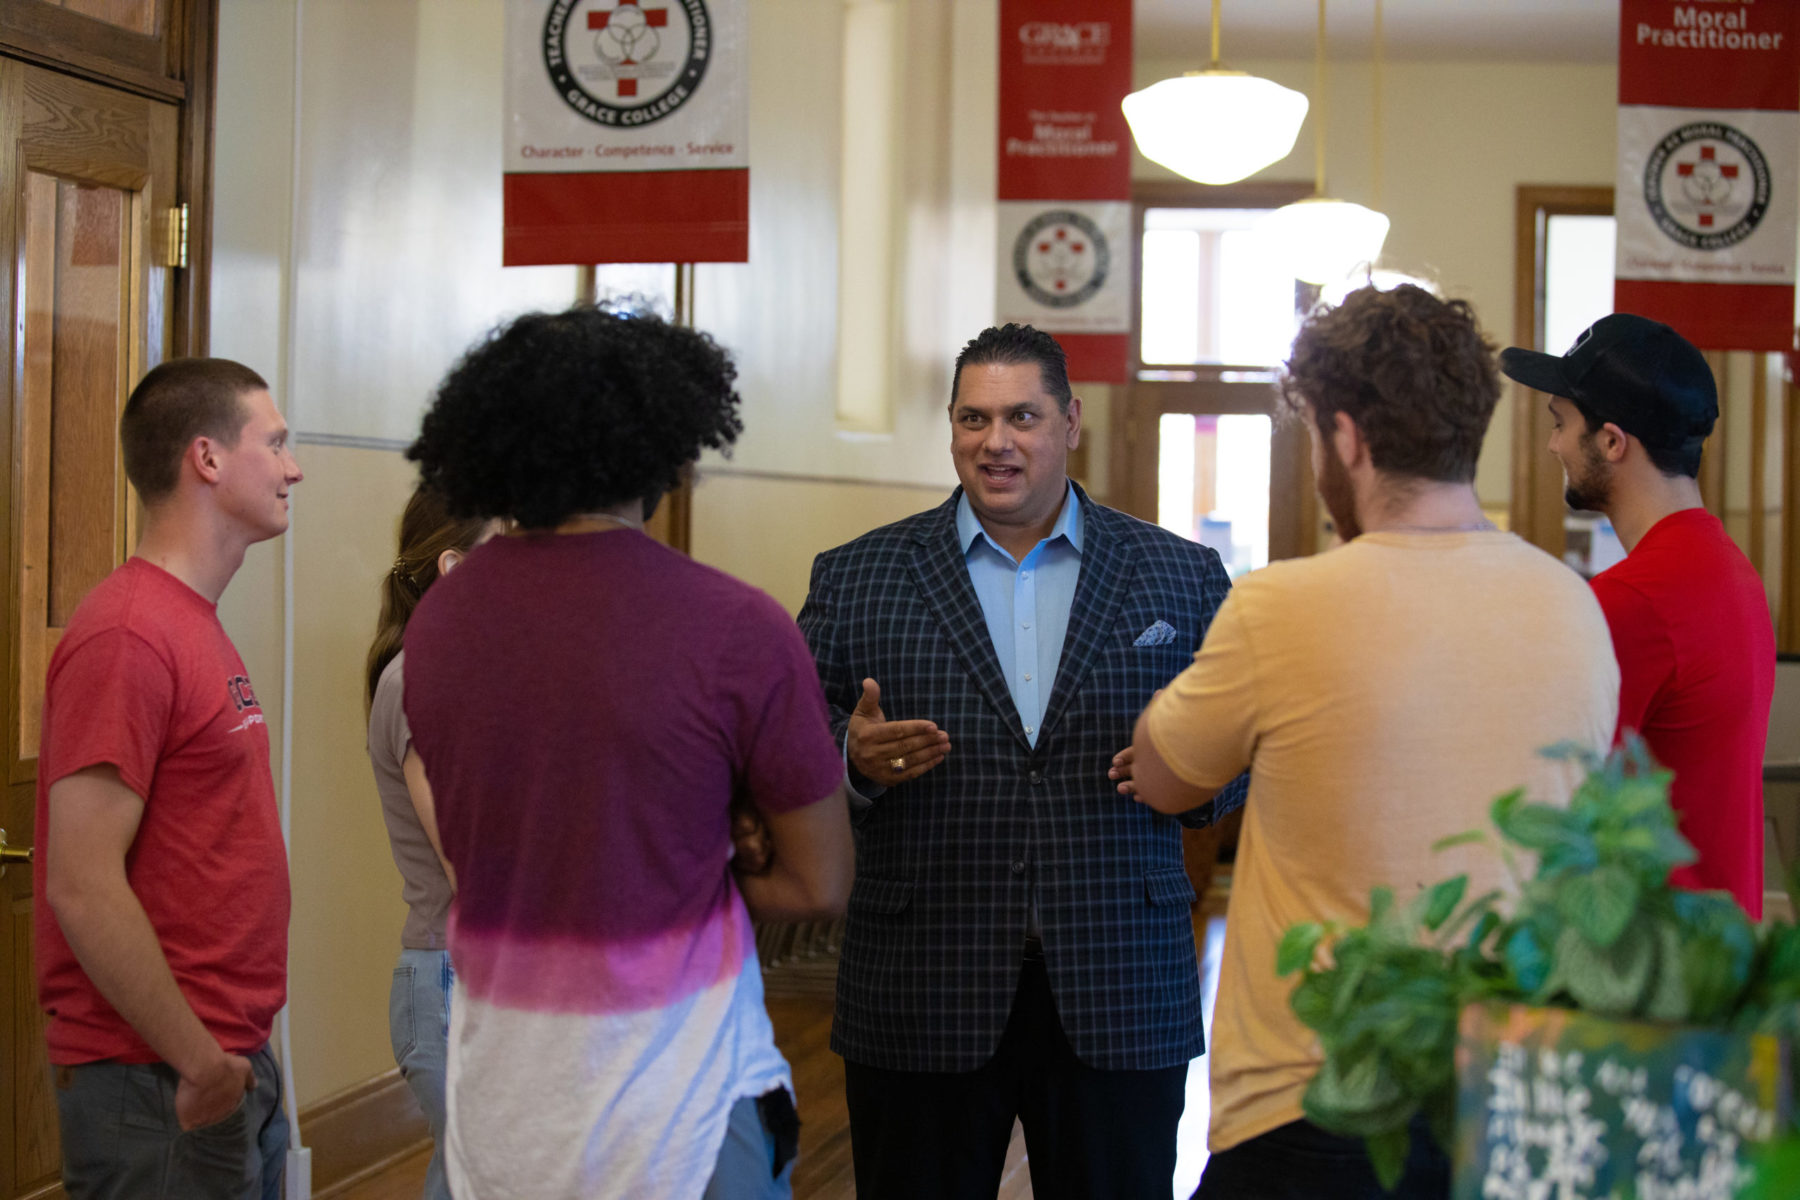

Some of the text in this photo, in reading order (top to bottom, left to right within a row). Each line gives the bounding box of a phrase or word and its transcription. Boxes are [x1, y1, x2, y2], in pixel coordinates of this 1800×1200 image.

[1674, 7, 1746, 29] Moral
[1637, 23, 1783, 49] Practitioner
[567, 85, 688, 125] GRACE COLLEGE
[521, 141, 734, 159] Character Competence Service
